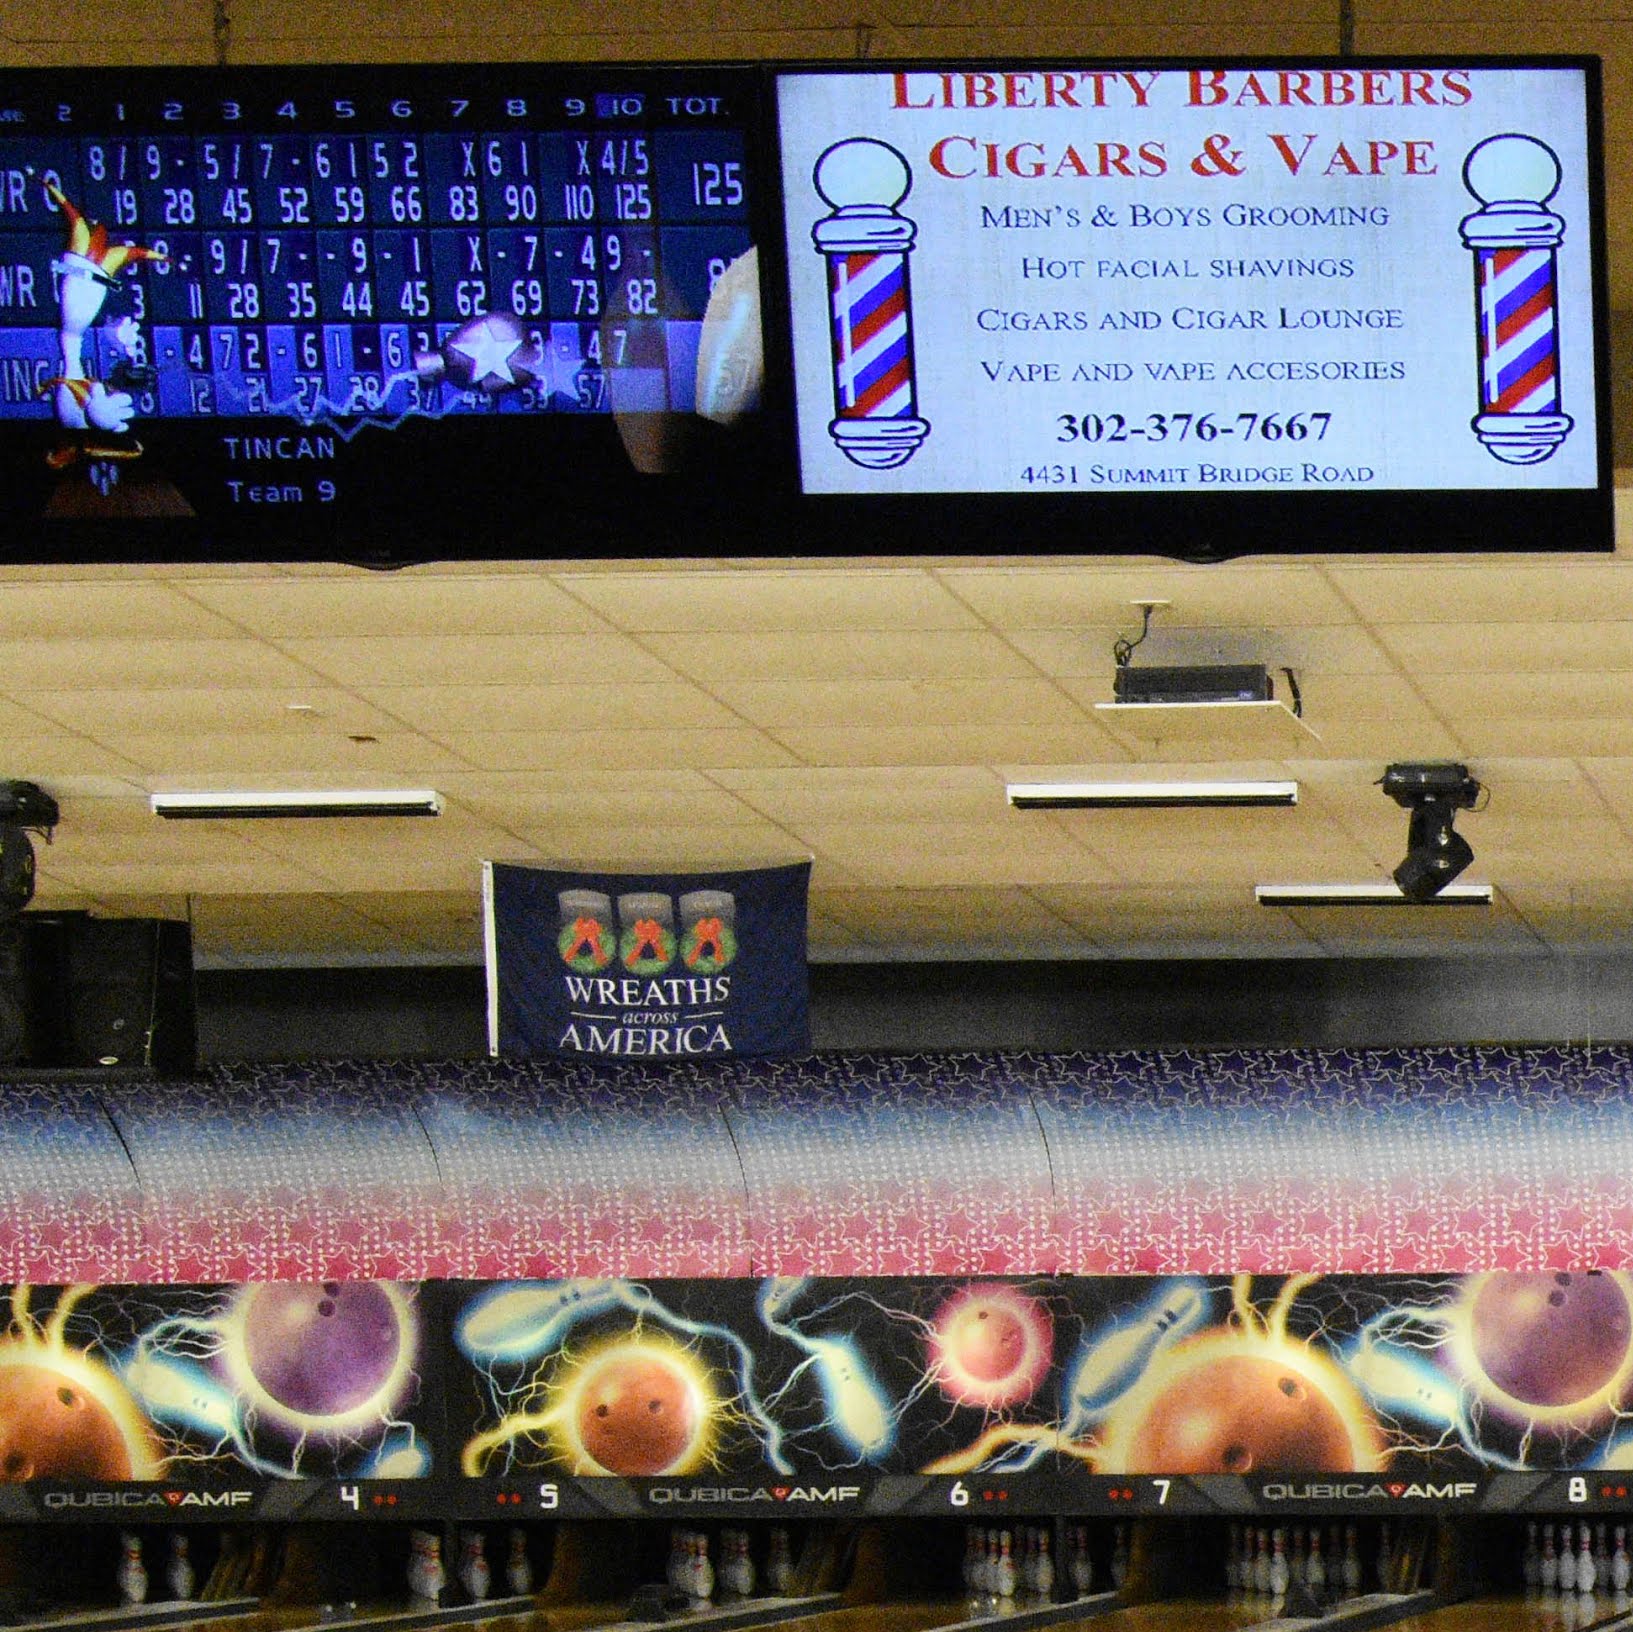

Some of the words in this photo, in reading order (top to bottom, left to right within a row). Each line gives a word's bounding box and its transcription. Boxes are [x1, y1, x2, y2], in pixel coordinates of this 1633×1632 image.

[929, 136, 1166, 178] CIGARS
[1191, 134, 1244, 176] &
[1269, 135, 1436, 175] VAPE
[694, 163, 742, 205] 125
[981, 205, 1080, 228] MEN'S
[1091, 205, 1118, 227] &
[1129, 204, 1211, 227] BOYS
[1223, 204, 1389, 226] GROOMING
[1022, 257, 1085, 279] HOT
[1098, 260, 1199, 279] FACIAL
[1210, 259, 1354, 278] SHAVINGS
[977, 308, 1088, 331] CIGARS
[1099, 311, 1162, 330] AND
[1172, 307, 1268, 329] CIGAR
[1279, 307, 1403, 329] LOUNGE
[981, 361, 1057, 382] VAPE
[1072, 363, 1133, 381] AND
[1144, 363, 1215, 381] VAPE
[1227, 362, 1405, 380] ACCESORIES
[1057, 412, 1331, 442] 302-376-7667
[224, 436, 334, 459] TINCAN
[1021, 465, 1077, 484] 4431
[1091, 465, 1188, 484] SUMMIT
[1198, 464, 1293, 483] BRIDGE
[1301, 463, 1374, 482] ROAD
[565, 976, 730, 1005] WREATHS
[622, 1012, 678, 1024] across
[559, 1024, 732, 1055] AMERICA
[340, 1486, 360, 1511] 4
[539, 1483, 559, 1509] 5
[788, 1486, 861, 1501] AMF
[949, 1480, 969, 1507] 6
[1152, 1480, 1173, 1505] 7
[1568, 1476, 1587, 1502] 8
